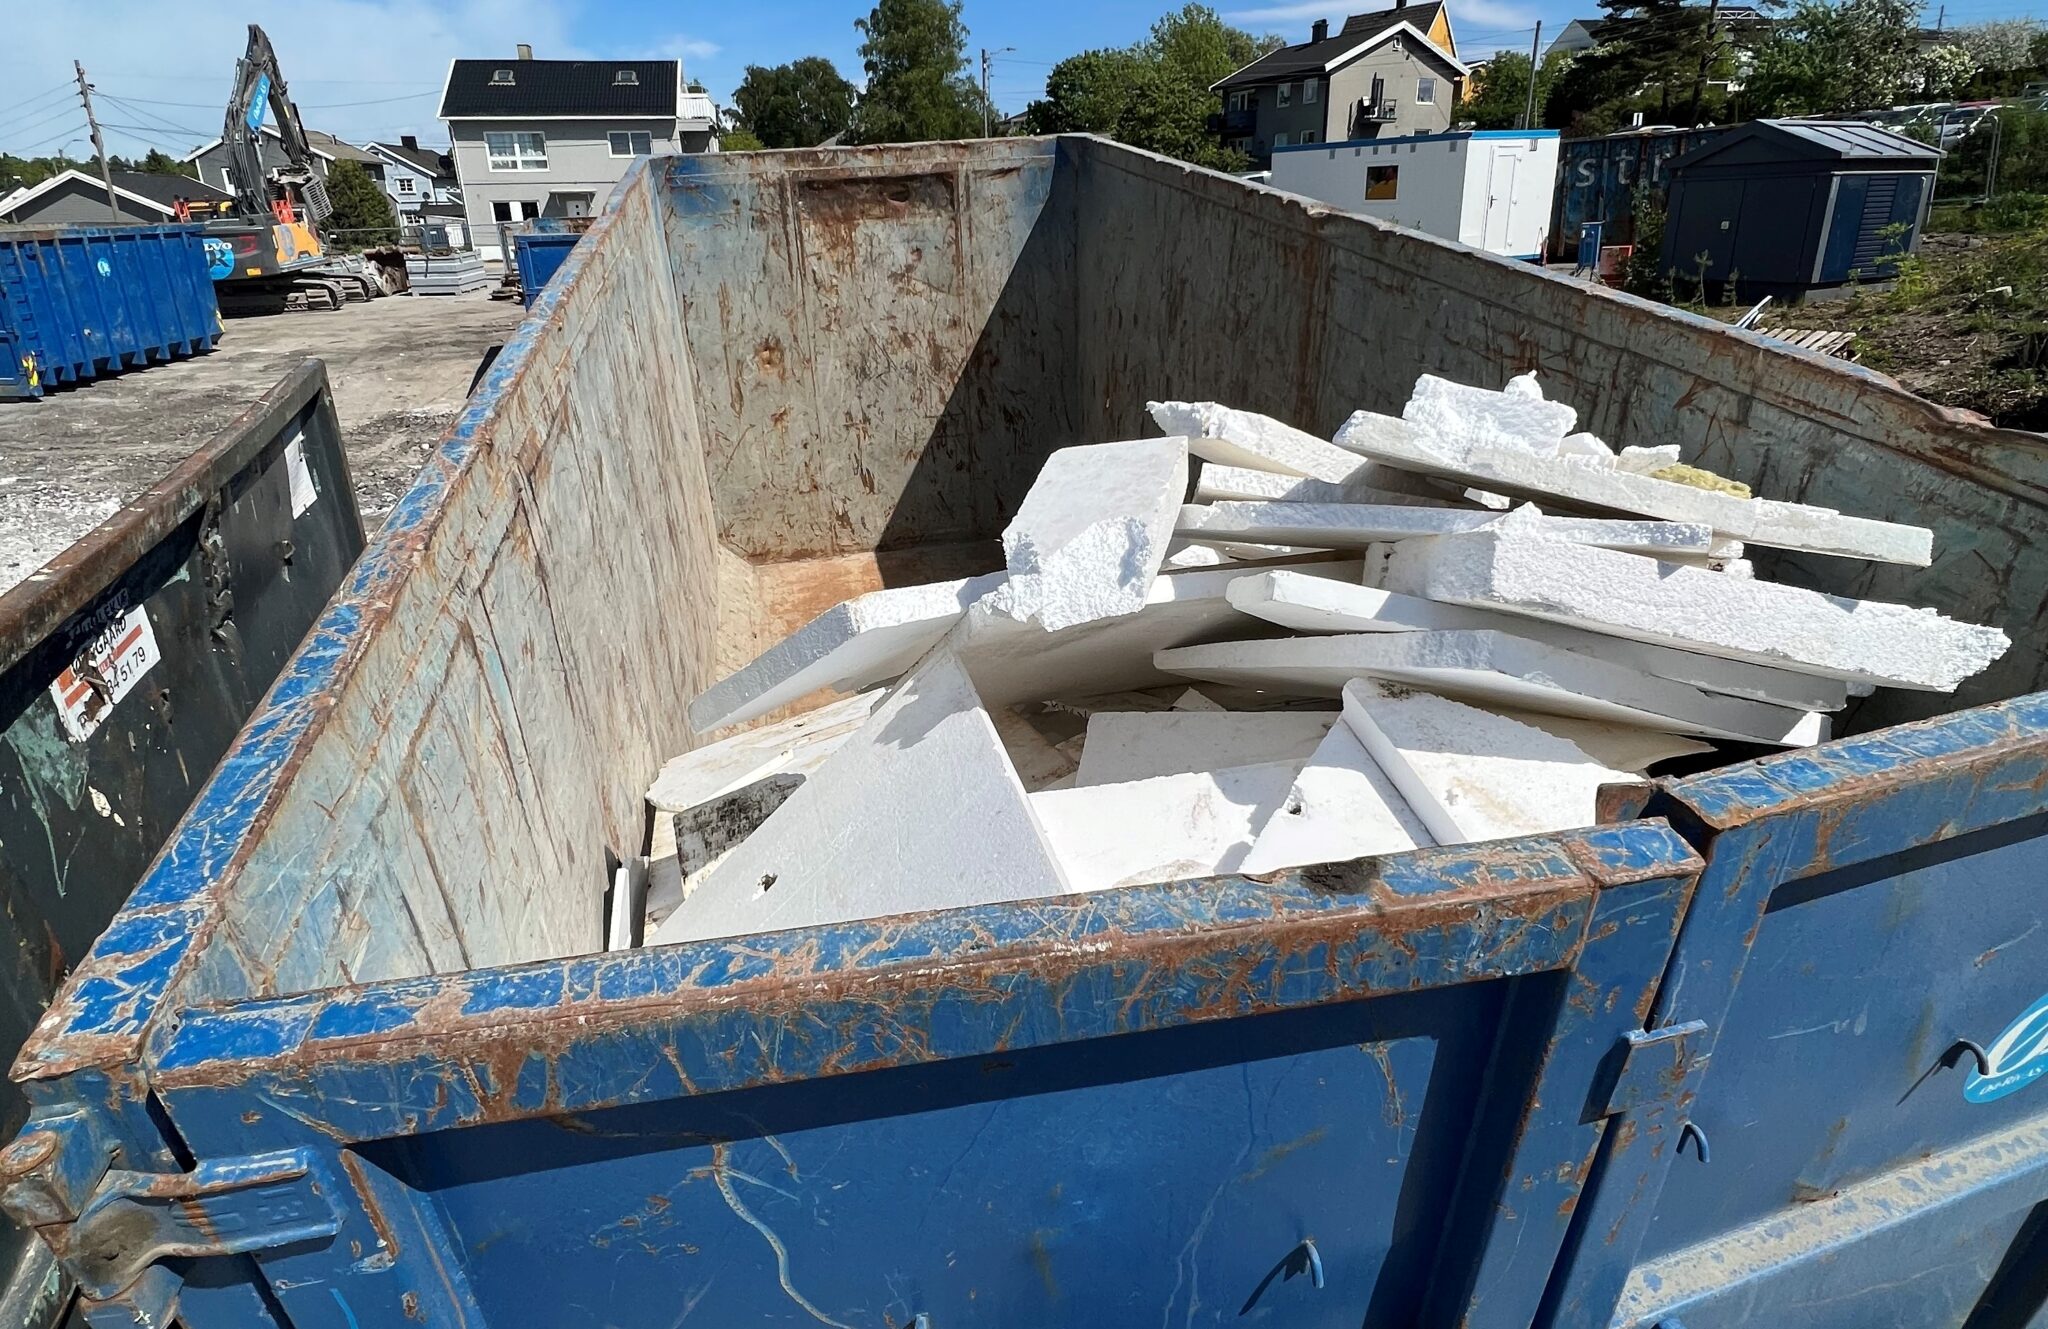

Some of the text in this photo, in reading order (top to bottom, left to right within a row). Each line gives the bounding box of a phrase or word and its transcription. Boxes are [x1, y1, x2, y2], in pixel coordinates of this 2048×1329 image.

[203, 242, 233, 251] LVO
[120, 660, 134, 682] 51
[132, 646, 146, 668] 79
